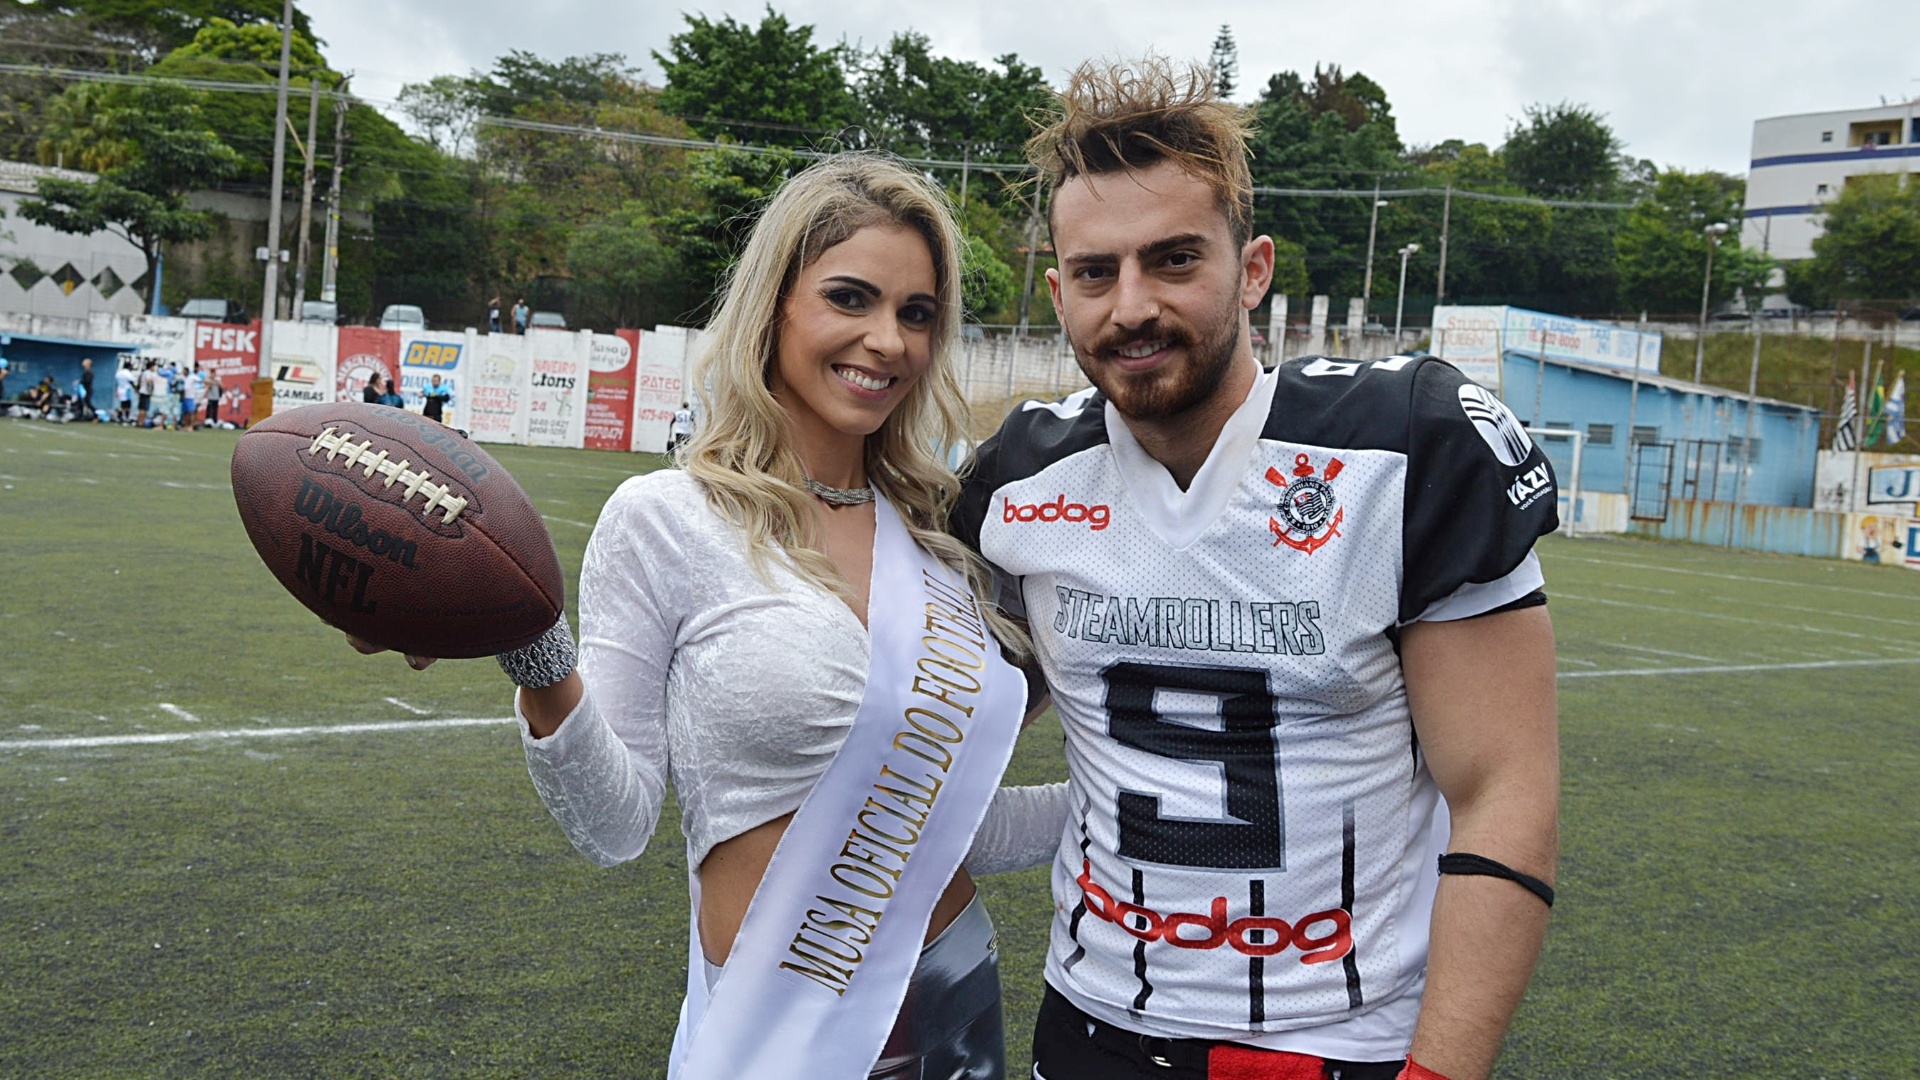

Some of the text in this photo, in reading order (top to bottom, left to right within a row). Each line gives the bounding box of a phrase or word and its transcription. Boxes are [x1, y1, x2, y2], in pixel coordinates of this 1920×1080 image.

[196, 325, 257, 353] FISK
[407, 343, 459, 367] DAP
[400, 375, 456, 391] DIADA
[1886, 470, 1916, 498] J
[294, 476, 421, 571] Wilson
[1003, 493, 1110, 531] bodog
[1302, 522, 1320, 530] 1910
[295, 532, 377, 616] NFL
[1053, 585, 1325, 656] STEAMROLLERS
[779, 567, 988, 998] MUSA OFICIAL DO FOOTBALL
[1097, 658, 1287, 873] 9
[1076, 858, 1354, 966] bodog
